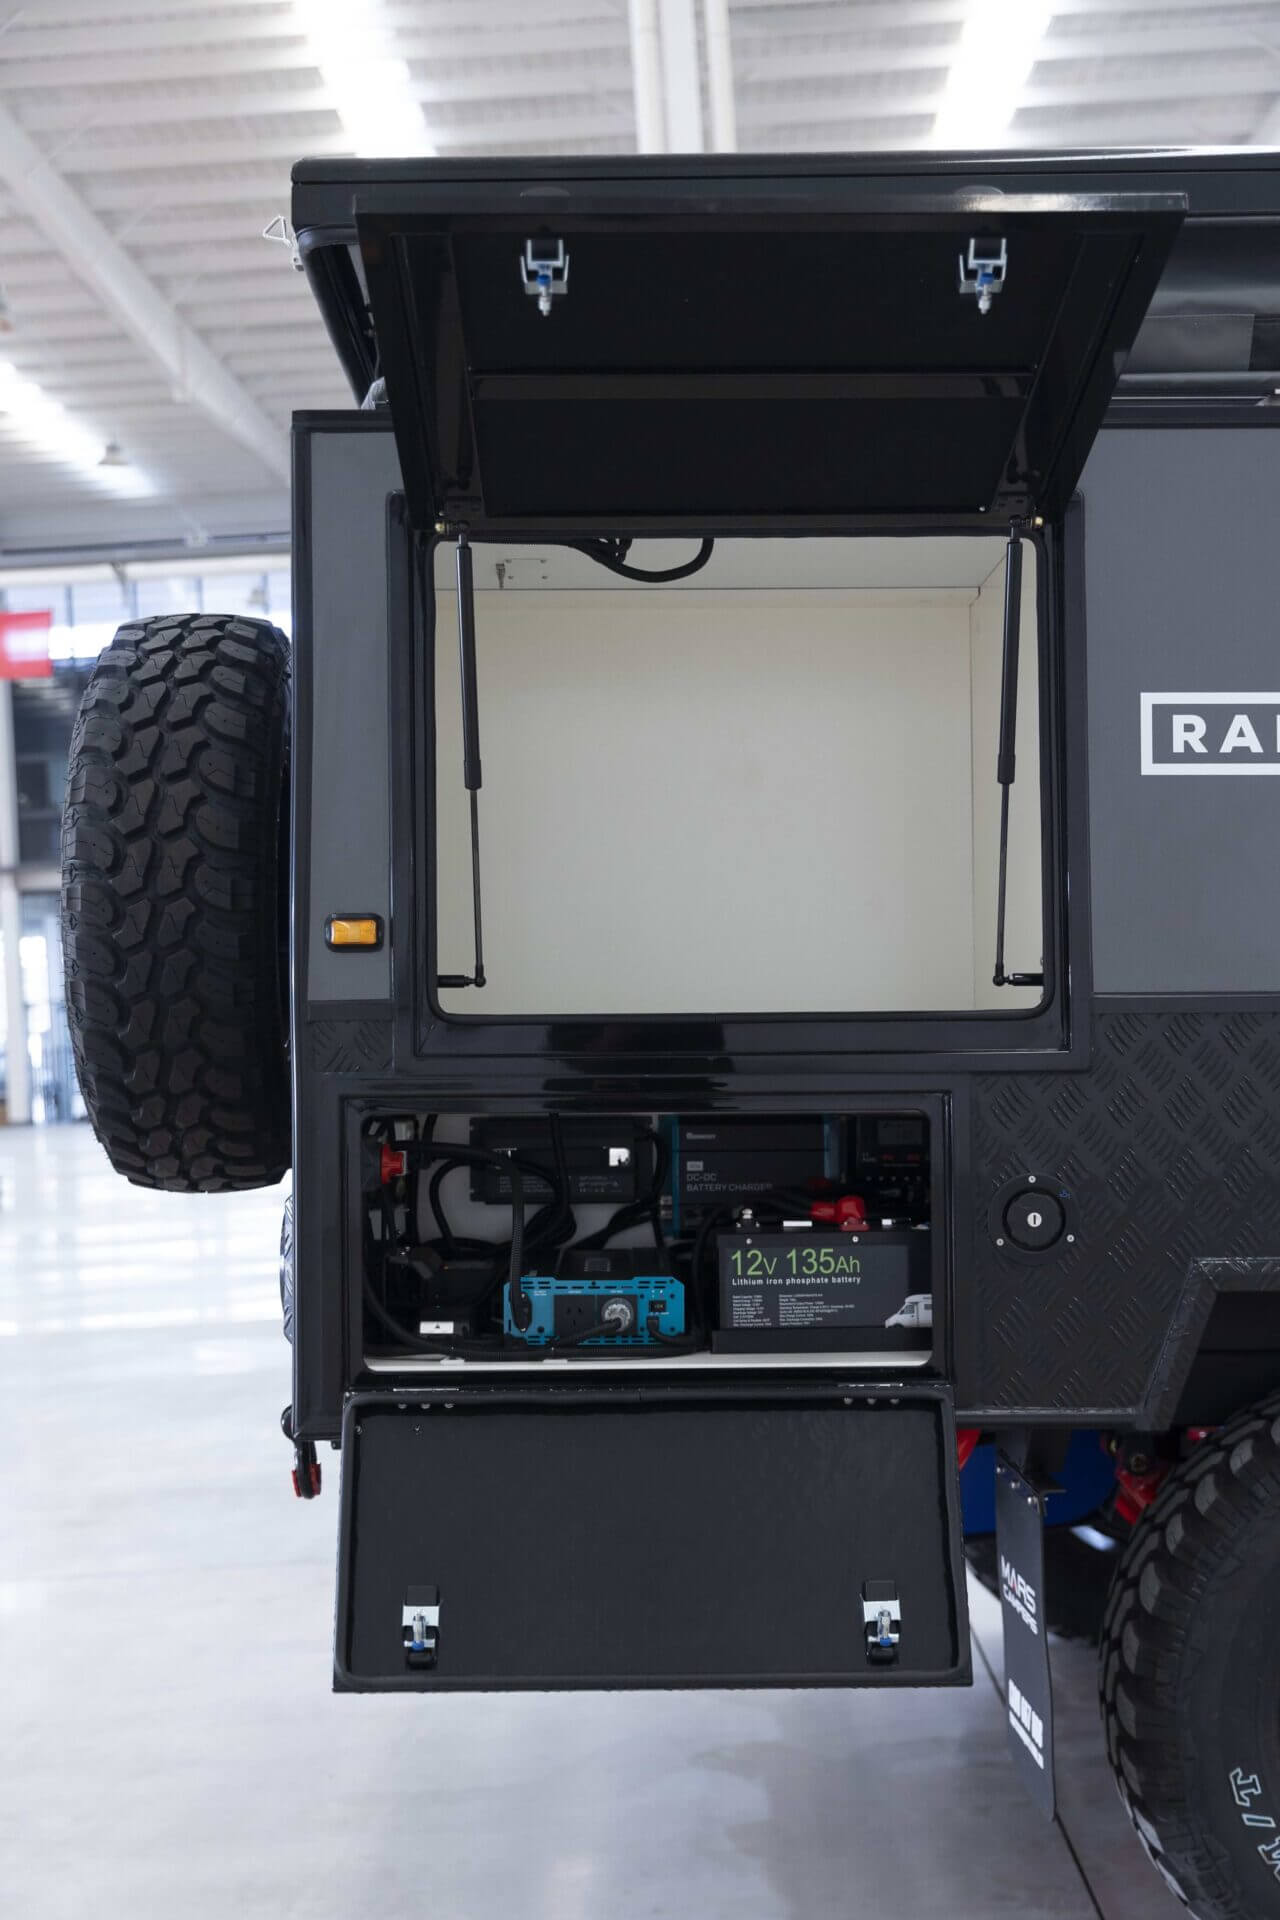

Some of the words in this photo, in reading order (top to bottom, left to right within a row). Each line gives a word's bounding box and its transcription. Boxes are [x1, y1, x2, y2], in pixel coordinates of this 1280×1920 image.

[1172, 714, 1280, 753] RA
[686, 1183, 727, 1192] BATTERY
[786, 1248, 860, 1275] 135Ah
[732, 1278, 764, 1286] Lithium
[766, 1277, 783, 1285] iron
[786, 1276, 829, 1286] phosphate
[832, 1275, 861, 1285] battery
[1001, 1555, 1037, 1615] MARS
